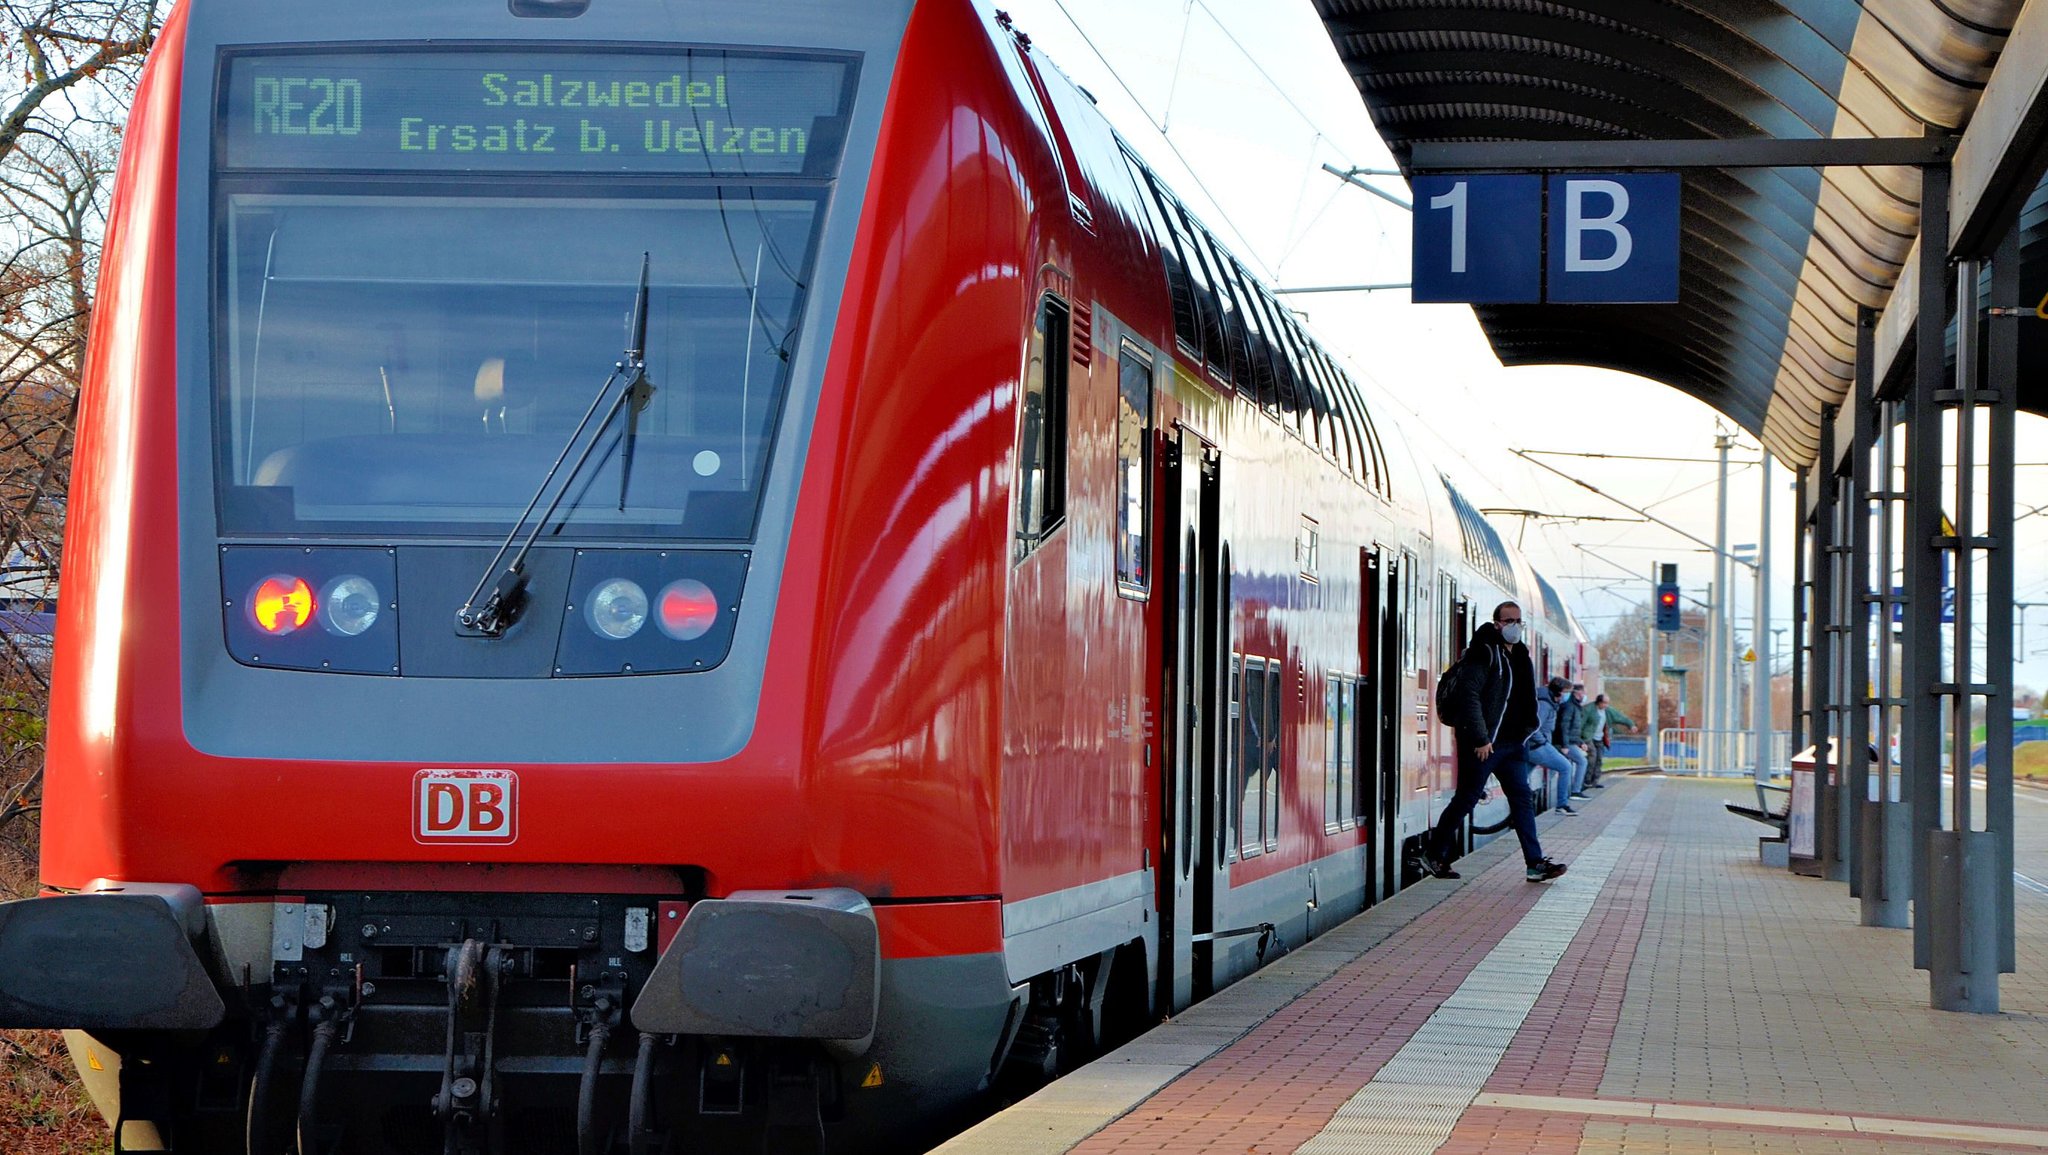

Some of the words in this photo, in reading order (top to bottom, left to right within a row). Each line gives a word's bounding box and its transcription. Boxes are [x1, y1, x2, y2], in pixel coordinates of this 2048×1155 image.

[254, 77, 362, 135] RE20
[482, 73, 727, 107] Salzwedel
[400, 117, 555, 151] Ersatz
[580, 119, 619, 152] b.
[645, 120, 806, 153] Uelzen
[1430, 181, 1467, 273] 1
[1564, 179, 1633, 272] B
[427, 783, 505, 831] DB
